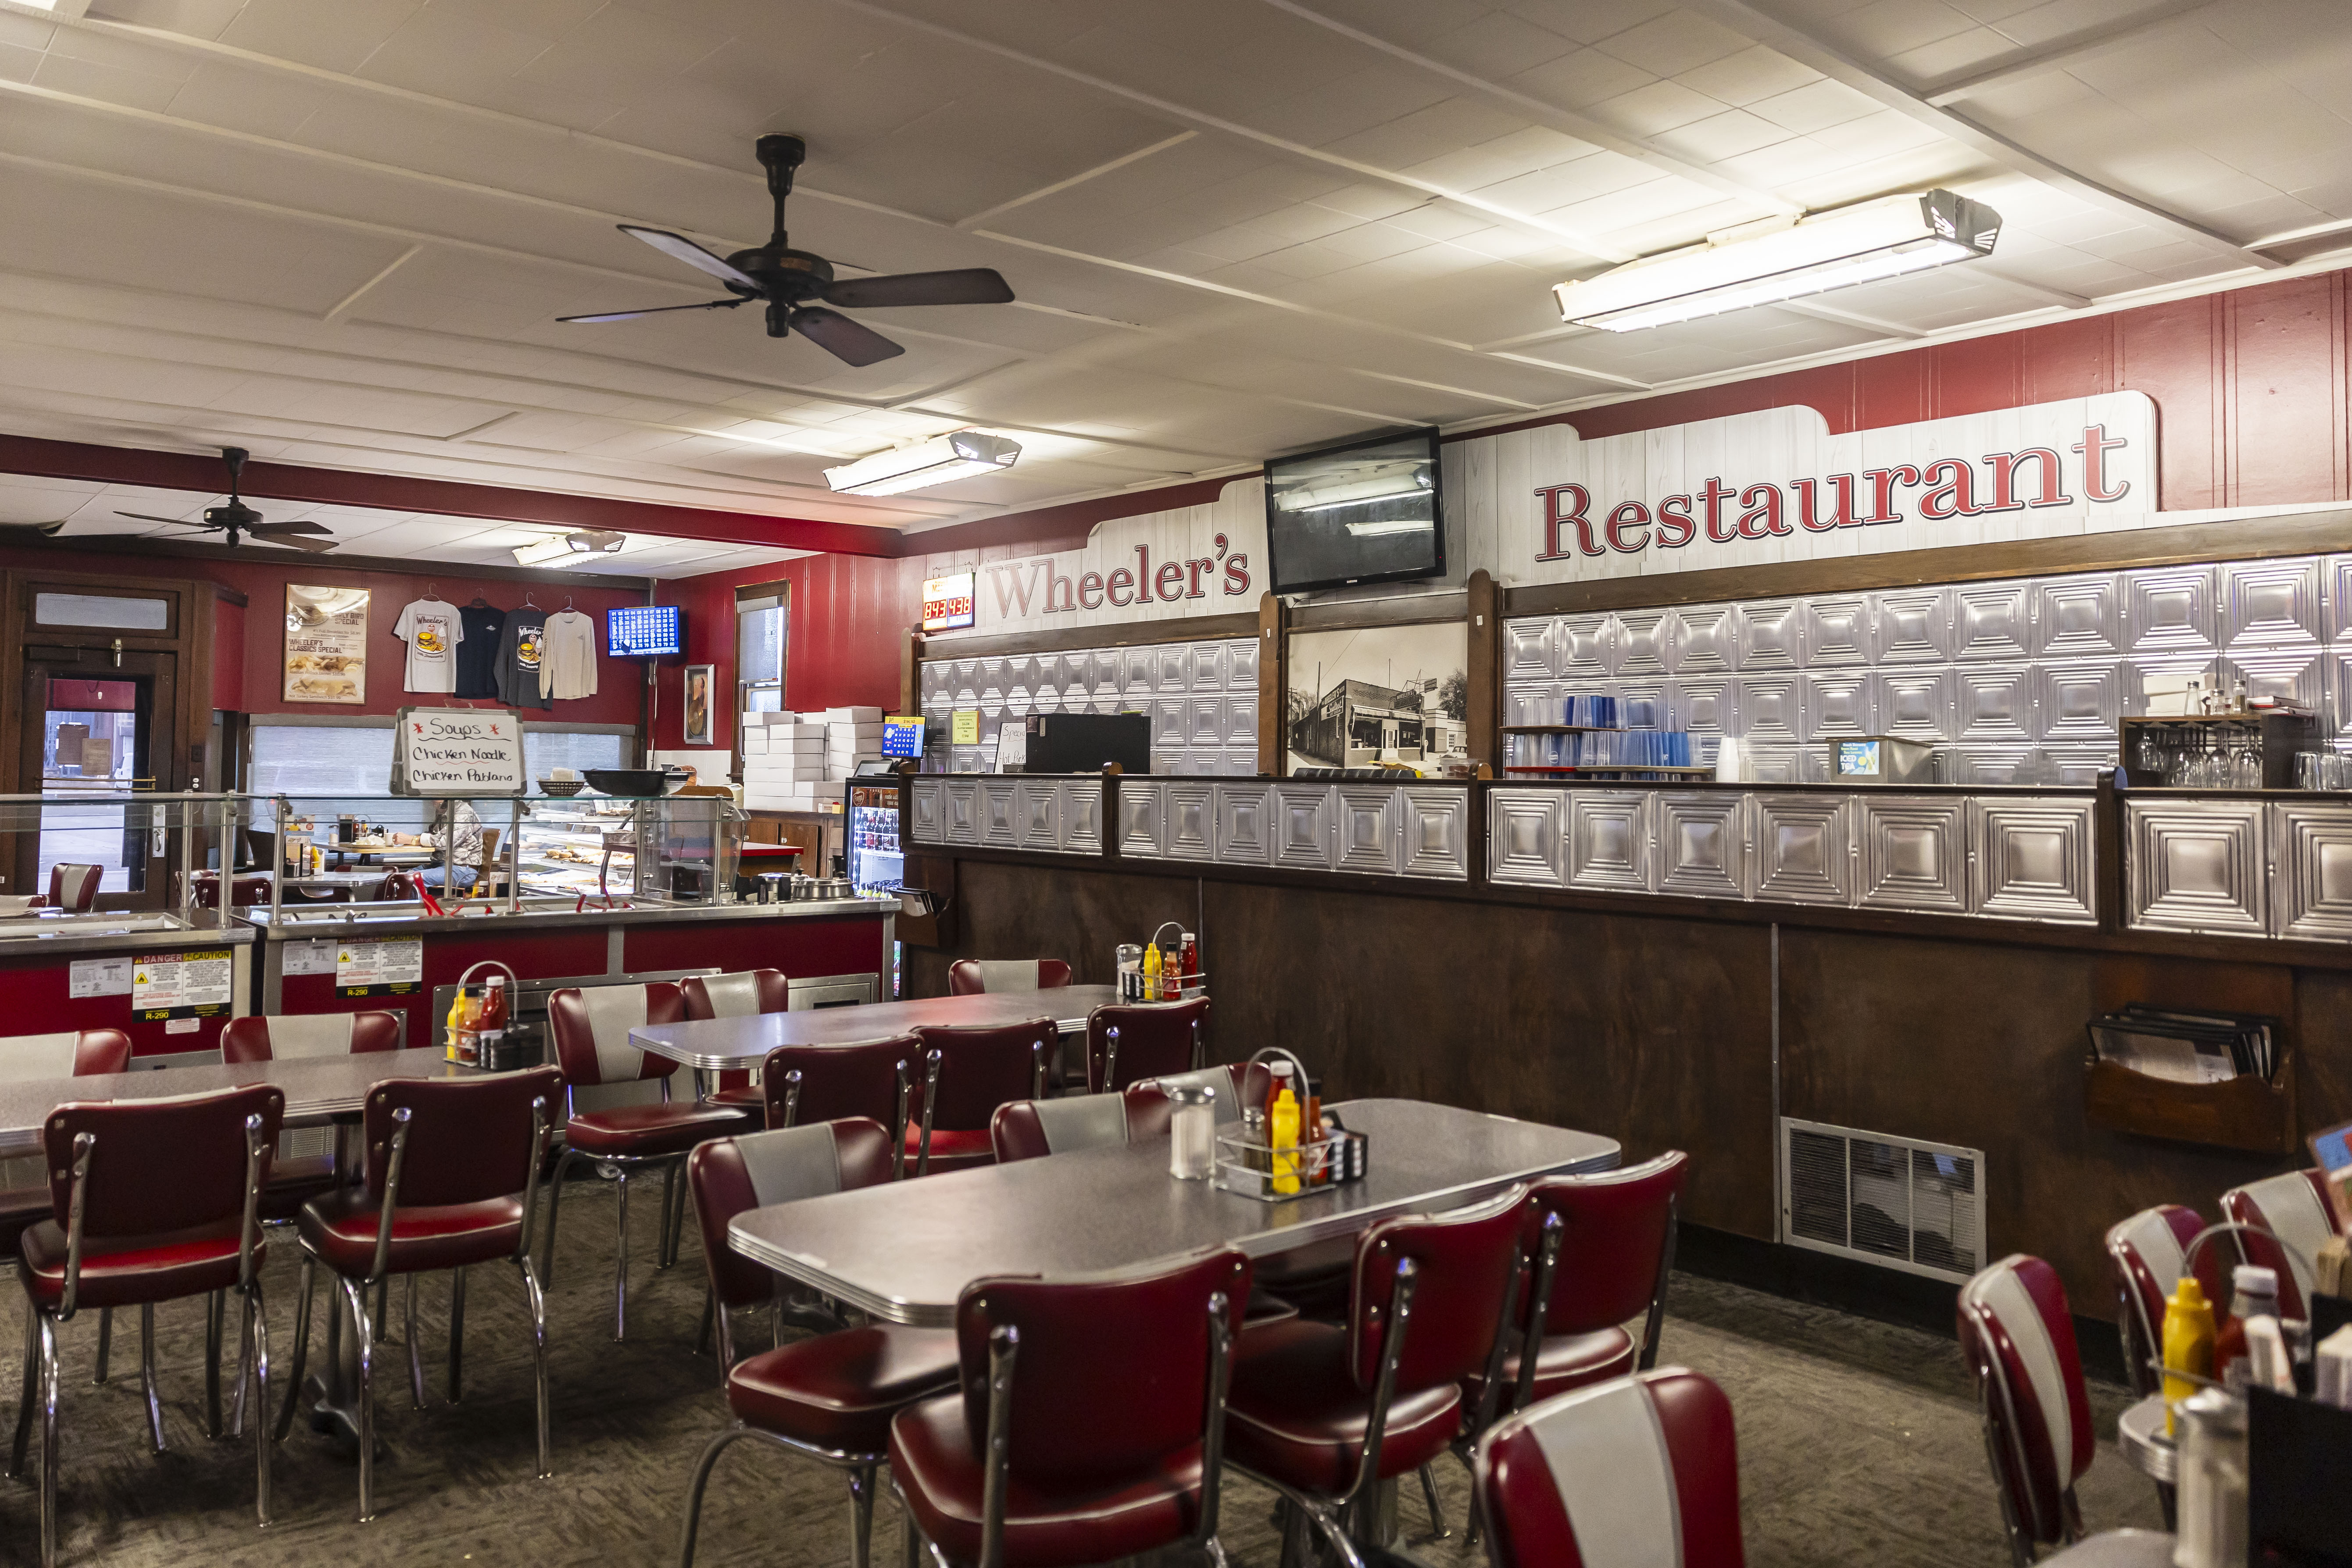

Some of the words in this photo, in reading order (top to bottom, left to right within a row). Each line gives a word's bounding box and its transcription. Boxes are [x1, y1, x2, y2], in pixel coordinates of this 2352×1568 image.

[1533, 423, 2131, 563] Restaurant
[985, 533, 1251, 618] Wheeler's
[925, 600, 946, 619] 843
[949, 596, 971, 614] 438
[416, 616, 447, 626] Wheeler's
[519, 627, 544, 637] Wheeler'
[430, 718, 481, 739] Soups
[1003, 726, 1026, 740] Specia
[413, 747, 467, 760] Chicken
[471, 748, 511, 761] Noodle
[999, 751, 1010, 764] Hot
[413, 769, 462, 782] Chicken
[144, 954, 182, 964] DANGER
[146, 1012, 169, 1020] R-290
